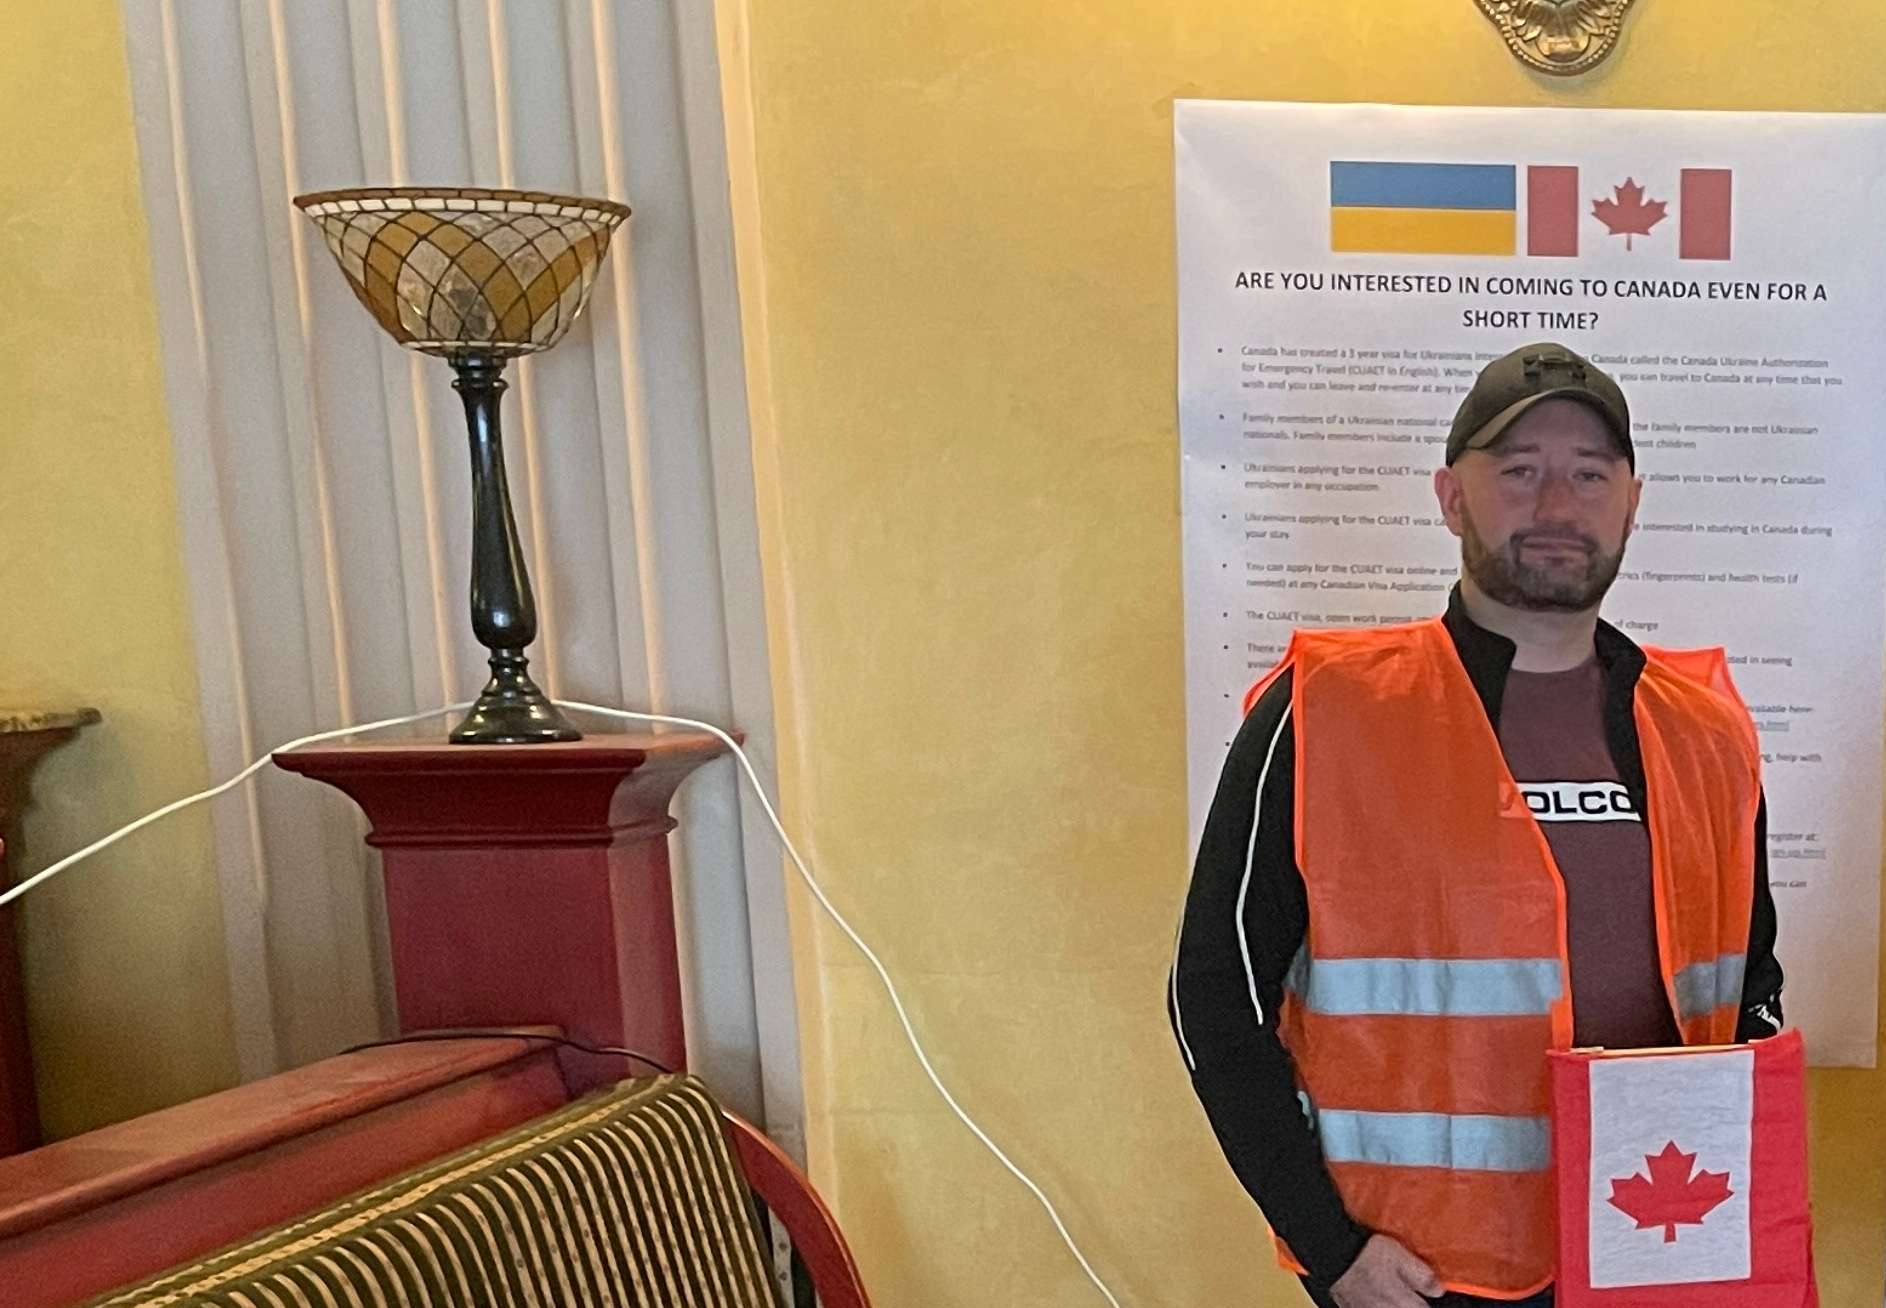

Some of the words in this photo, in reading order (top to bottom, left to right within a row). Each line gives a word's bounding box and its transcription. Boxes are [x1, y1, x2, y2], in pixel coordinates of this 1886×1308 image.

[1235, 272, 1274, 289] ARE
[1281, 273, 1323, 290] YOU
[1331, 274, 1451, 293] INTERESTED
[1458, 277, 1479, 294] IN
[1486, 277, 1573, 297] COMING
[1580, 279, 1607, 297] TO
[1614, 280, 1701, 299] CANADA
[1707, 282, 1759, 300] EVEN
[1767, 283, 1806, 301] FOR
[1813, 284, 1827, 301] A
[1462, 310, 1530, 329] SHORT
[1538, 312, 1599, 330] TIME?
[1240, 346, 1278, 356] Canada
[1281, 347, 1297, 357] has
[1381, 349, 1400, 359] visa
[1403, 349, 1417, 359] for
[1420, 349, 1472, 360] Ukrainians
[1591, 353, 1628, 363] Canada
[1662, 354, 1678, 364] the
[1681, 355, 1718, 365] Canada
[1720, 355, 1758, 366] Ukraine
[1241, 362, 1256, 372] for
[1258, 363, 1313, 376] Emergency
[1315, 364, 1346, 374] Travel
[1620, 373, 1638, 383] you
[1704, 372, 1740, 383] Canada
[1756, 376, 1773, 386] any
[1824, 377, 1843, 387] you
[1288, 382, 1306, 392] you
[1329, 381, 1355, 391] leave
[1434, 386, 1452, 396] any
[1242, 413, 1274, 425] Family
[1276, 413, 1323, 424] members
[1347, 415, 1394, 426] Ukrainian
[1632, 420, 1648, 430] the
[1651, 421, 1681, 433] family
[1684, 421, 1730, 432] members
[1733, 425, 1749, 433] are
[1293, 430, 1325, 443] Family
[1327, 431, 1374, 442] members
[1298, 464, 1339, 477] applying
[1341, 465, 1356, 475] for
[1358, 466, 1374, 476] the
[1682, 474, 1700, 484] you
[1717, 473, 1742, 483] work
[1744, 473, 1758, 483] for
[1761, 476, 1778, 486] any
[1781, 474, 1826, 484] Canadian
[1298, 514, 1340, 526] applying
[1342, 515, 1356, 525] for
[1359, 515, 1375, 525] the
[1762, 523, 1798, 534] Canada
[1286, 562, 1312, 574] apply
[1314, 563, 1329, 573] for
[1331, 563, 1347, 573] the
[1439, 565, 1458, 575] and
[1707, 572, 1726, 582] and
[1321, 579, 1366, 590] Canadian
